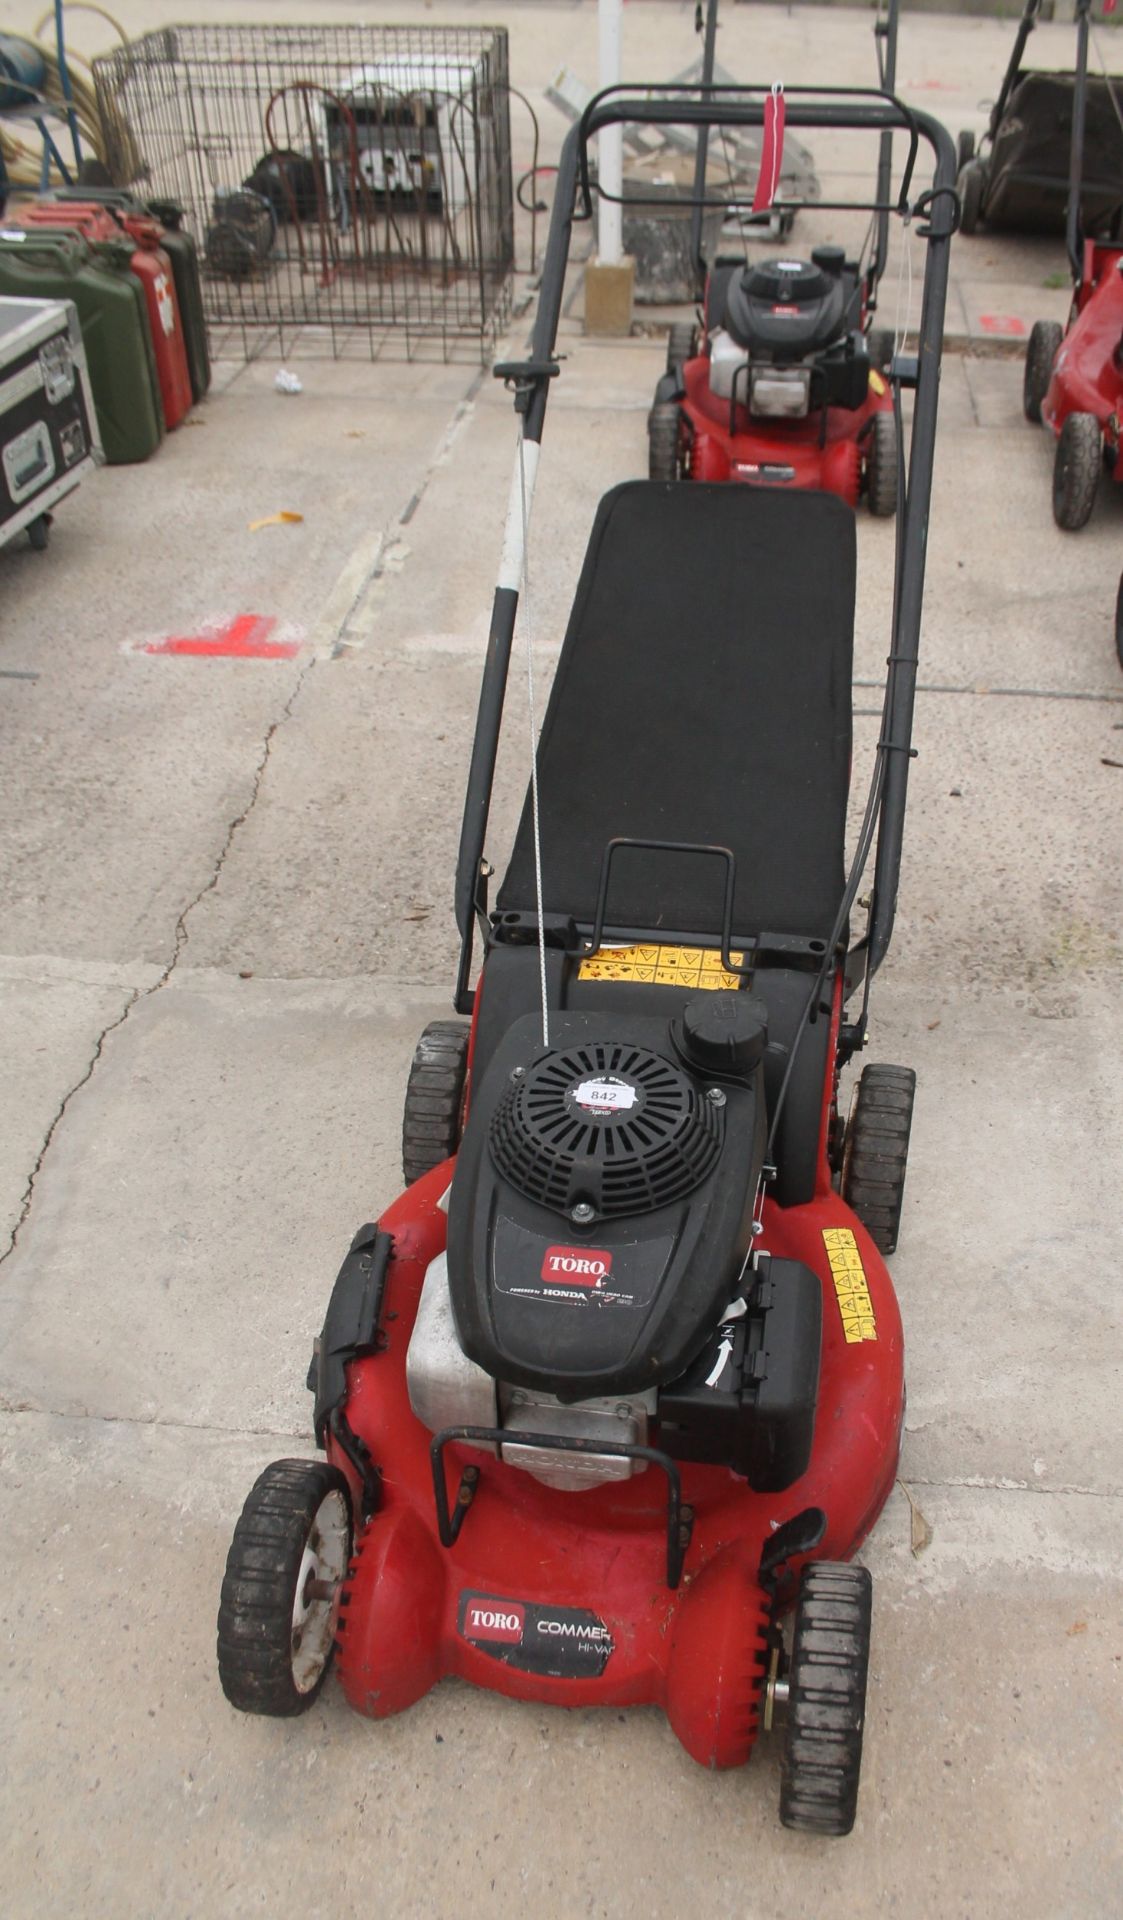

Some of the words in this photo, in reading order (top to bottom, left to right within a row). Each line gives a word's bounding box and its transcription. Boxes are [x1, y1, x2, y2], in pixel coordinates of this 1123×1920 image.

[591, 1090, 617, 1102] 842
[549, 1256, 605, 1275] TORO
[542, 1288, 588, 1301] HONDA
[470, 1609, 520, 1631] TORO
